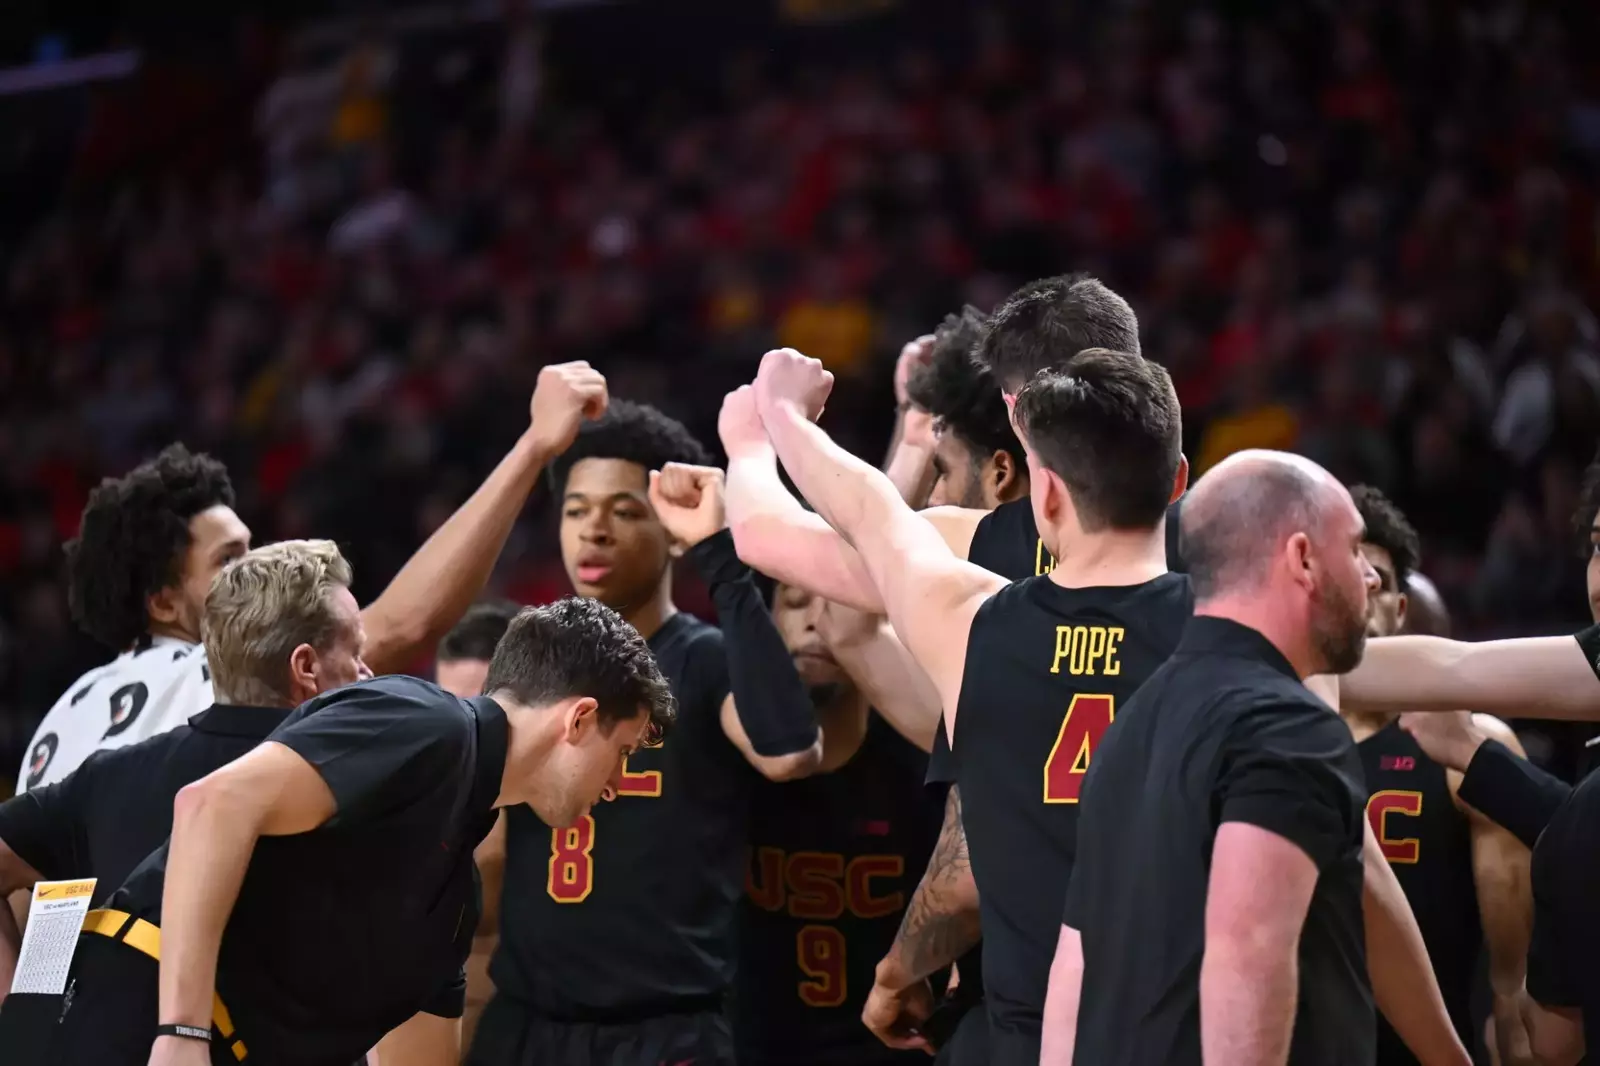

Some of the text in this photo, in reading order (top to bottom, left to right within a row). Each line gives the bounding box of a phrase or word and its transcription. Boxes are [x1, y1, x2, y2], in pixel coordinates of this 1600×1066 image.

[1050, 625, 1124, 675] POPE
[1043, 693, 1114, 803] 4
[546, 813, 595, 904] 8
[743, 845, 905, 920] USC
[796, 924, 847, 1008] 9
